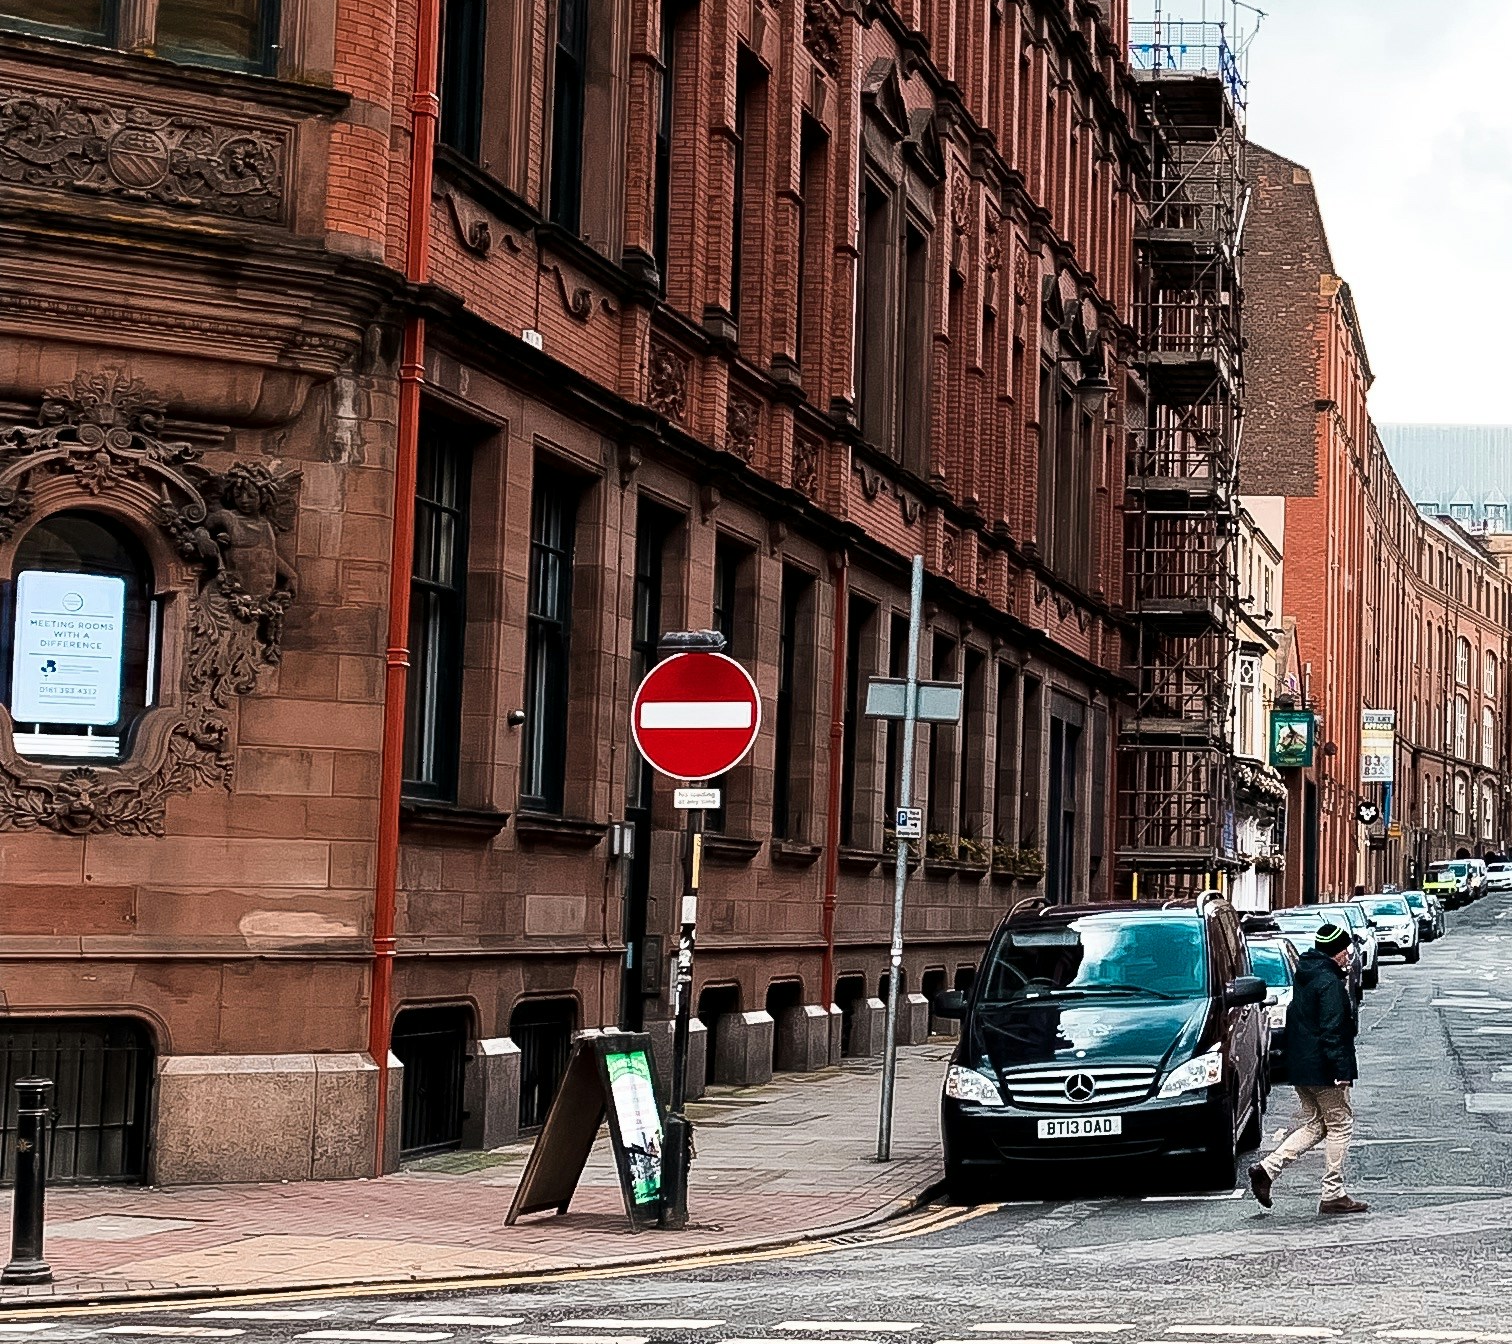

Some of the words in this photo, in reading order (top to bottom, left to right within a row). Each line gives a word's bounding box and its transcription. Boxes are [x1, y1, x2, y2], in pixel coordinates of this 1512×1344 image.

[30, 619, 75, 629] MEETING
[78, 620, 114, 631] ROOMS
[53, 630, 80, 639] WITH
[40, 639, 102, 650] DIFFERENCE
[1047, 1120, 1080, 1136] BT13
[1083, 1118, 1113, 1134] OAD
